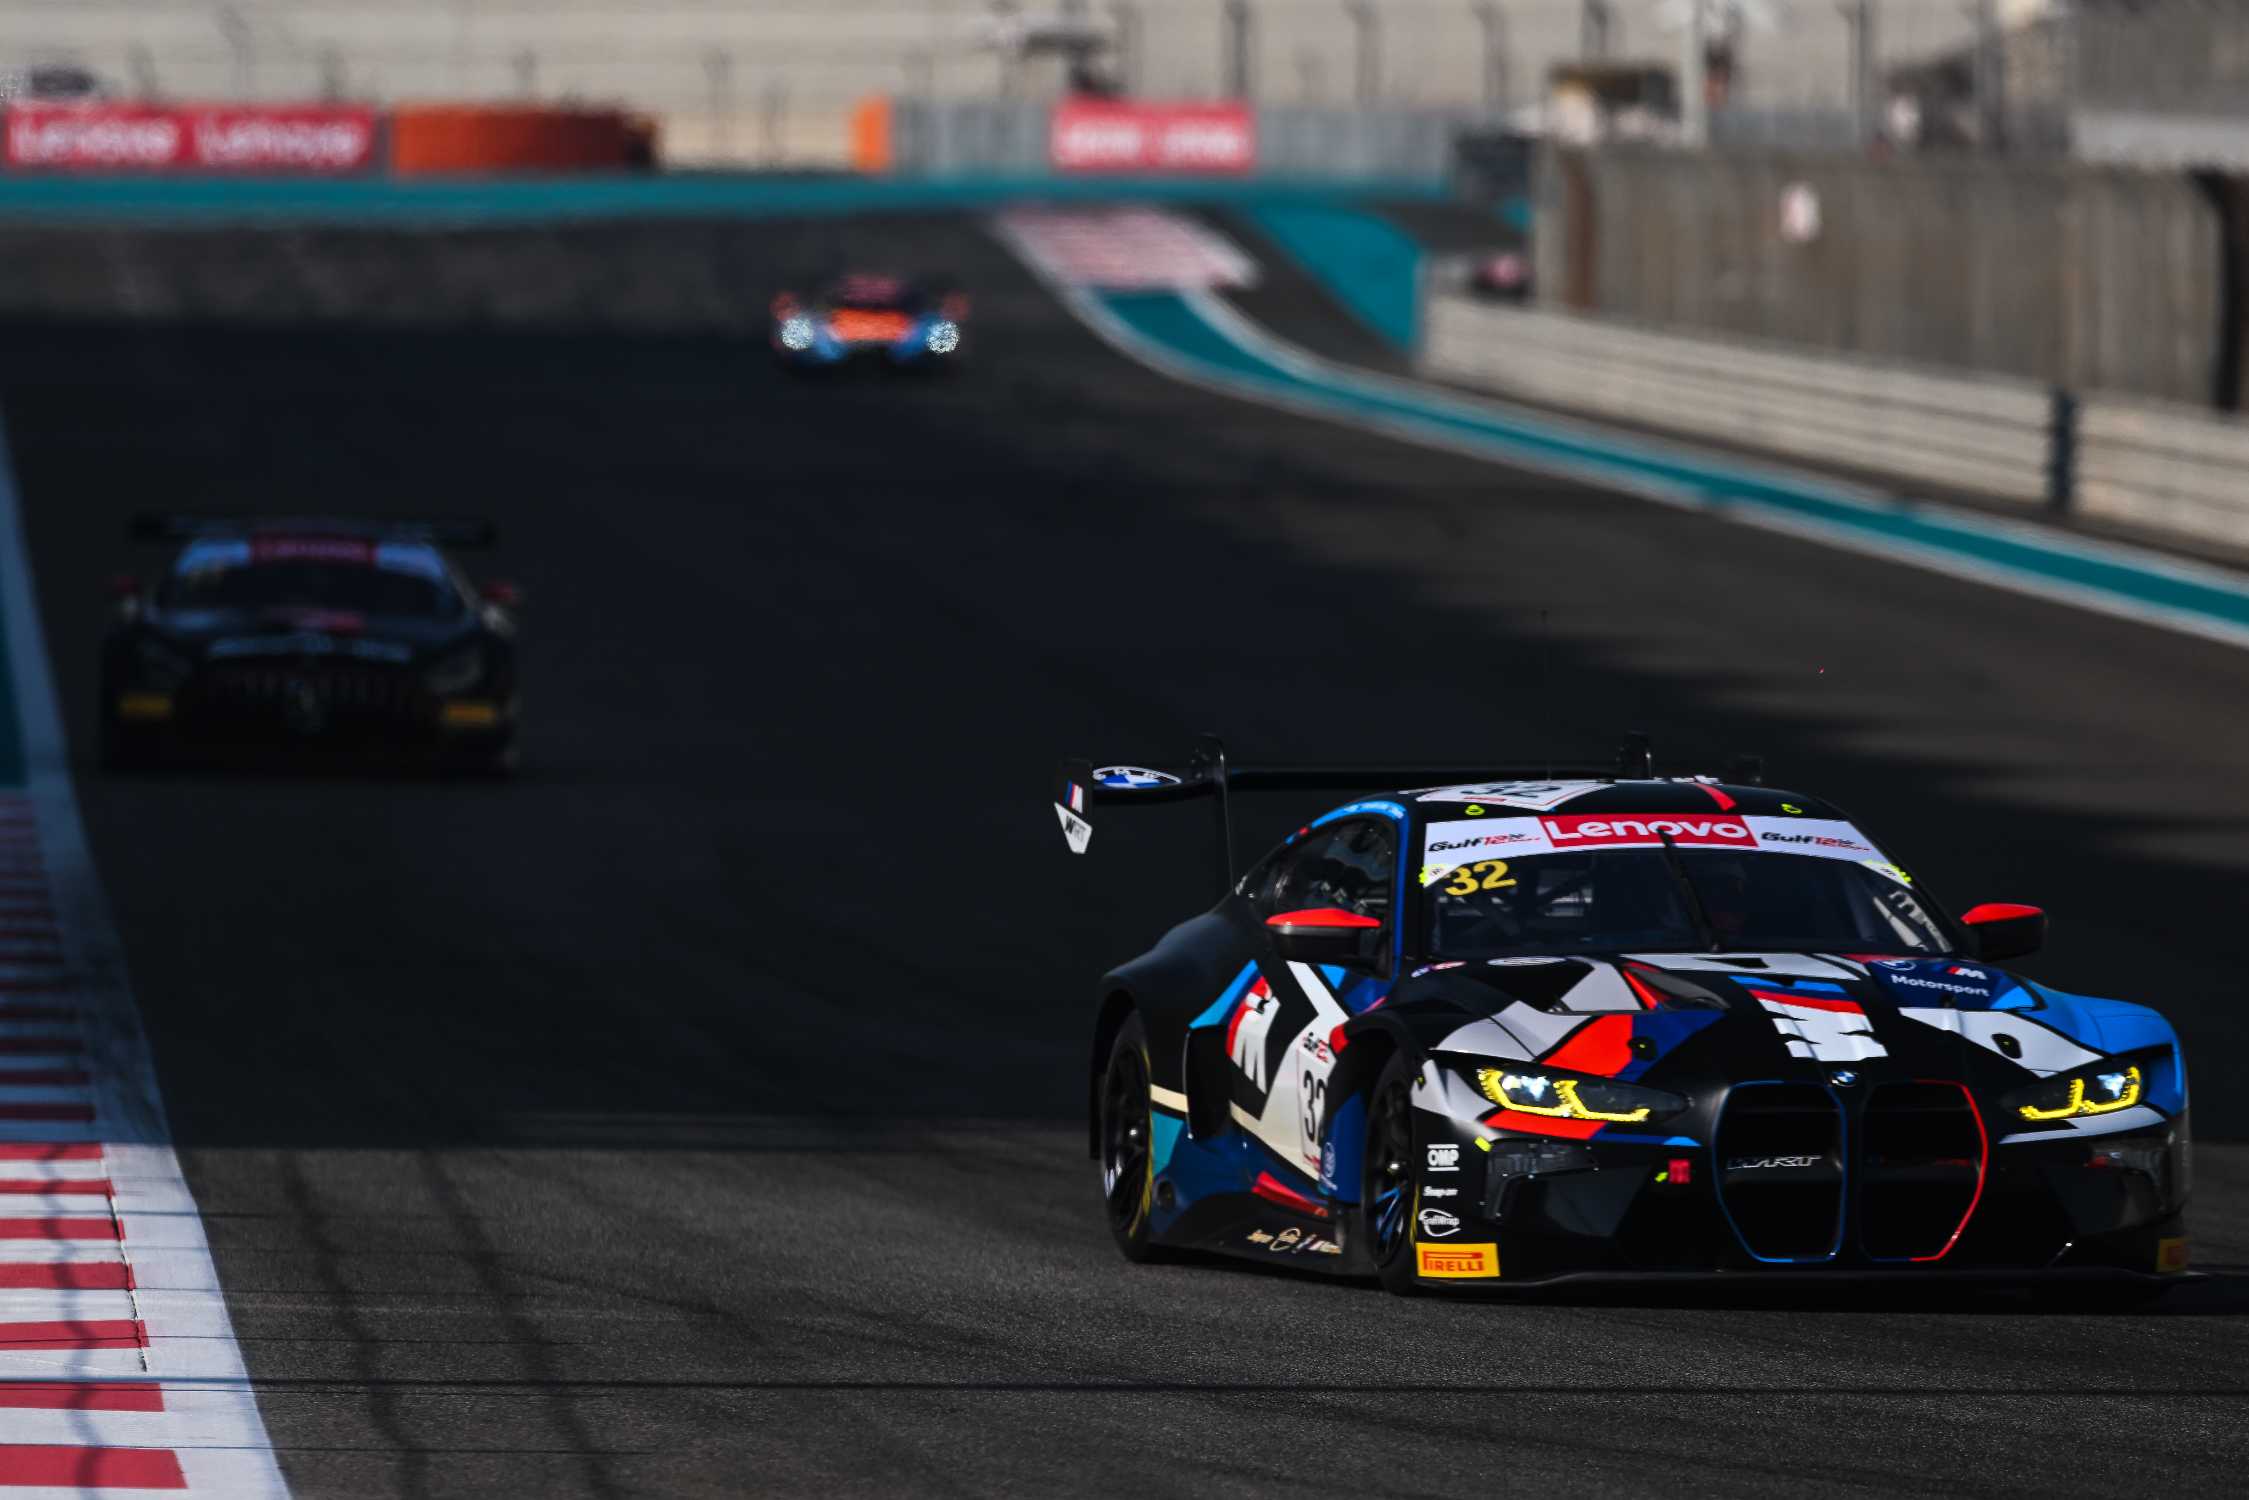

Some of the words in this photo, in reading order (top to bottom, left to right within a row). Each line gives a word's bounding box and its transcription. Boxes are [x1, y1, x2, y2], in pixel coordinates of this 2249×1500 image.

[1544, 819, 1748, 840] Lenovo
[1444, 859, 1518, 896] 32
[1891, 974, 1990, 997] Motorsport
[1427, 1149, 1460, 1167] OMP
[1423, 1251, 1485, 1271] PIRELLI
